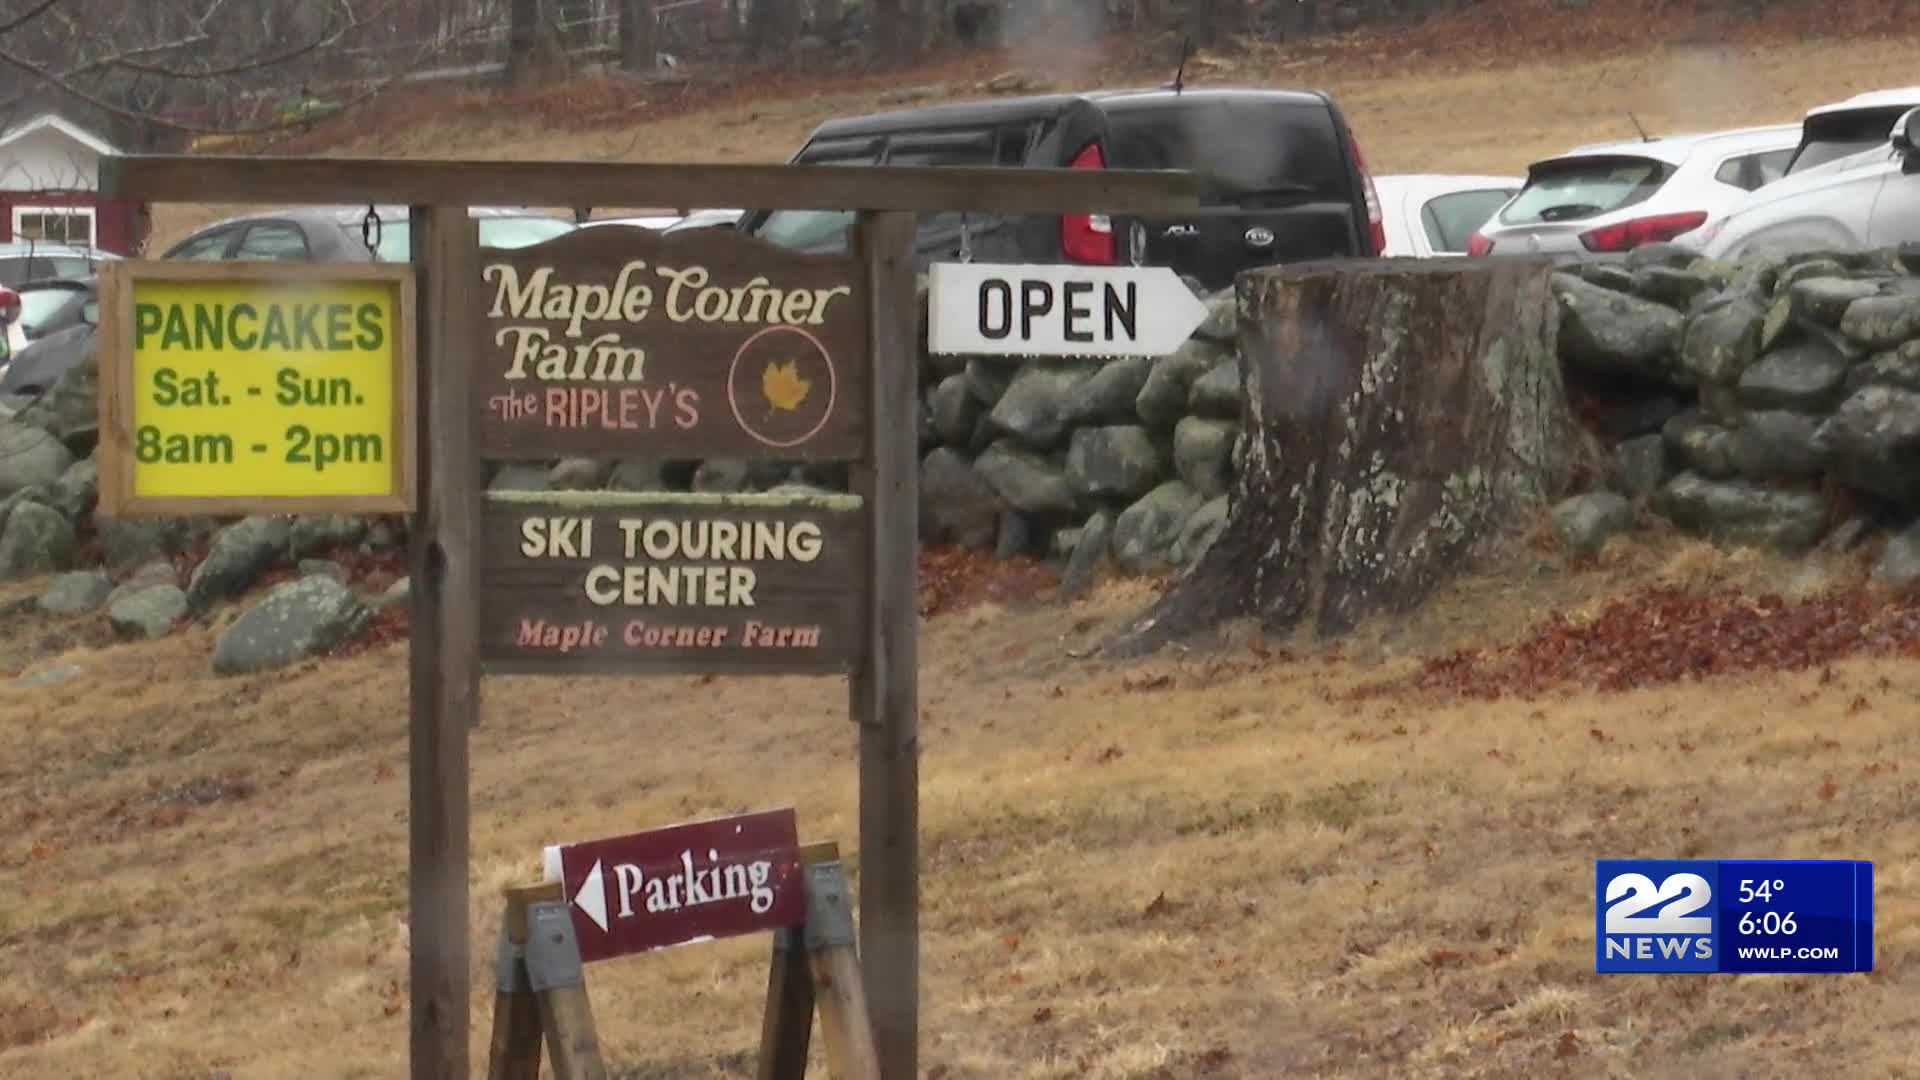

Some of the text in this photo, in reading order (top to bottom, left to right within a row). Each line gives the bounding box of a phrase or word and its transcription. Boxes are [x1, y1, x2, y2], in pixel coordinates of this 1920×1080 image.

[483, 260, 851, 338] Maple Corner
[978, 278, 1137, 342] OPEN
[134, 303, 385, 351] PANCAKES
[495, 326, 646, 382] Farm
[152, 367, 232, 406] Sat.
[275, 367, 365, 406] Sun.
[545, 383, 700, 430] RIPLEY'S
[135, 425, 234, 464] 8am
[284, 424, 384, 472] 2pm
[520, 516, 824, 562] SKI TOURING
[583, 564, 758, 606] CENTER
[515, 618, 821, 652] Maple Corner Farm
[613, 848, 774, 918] Parking
